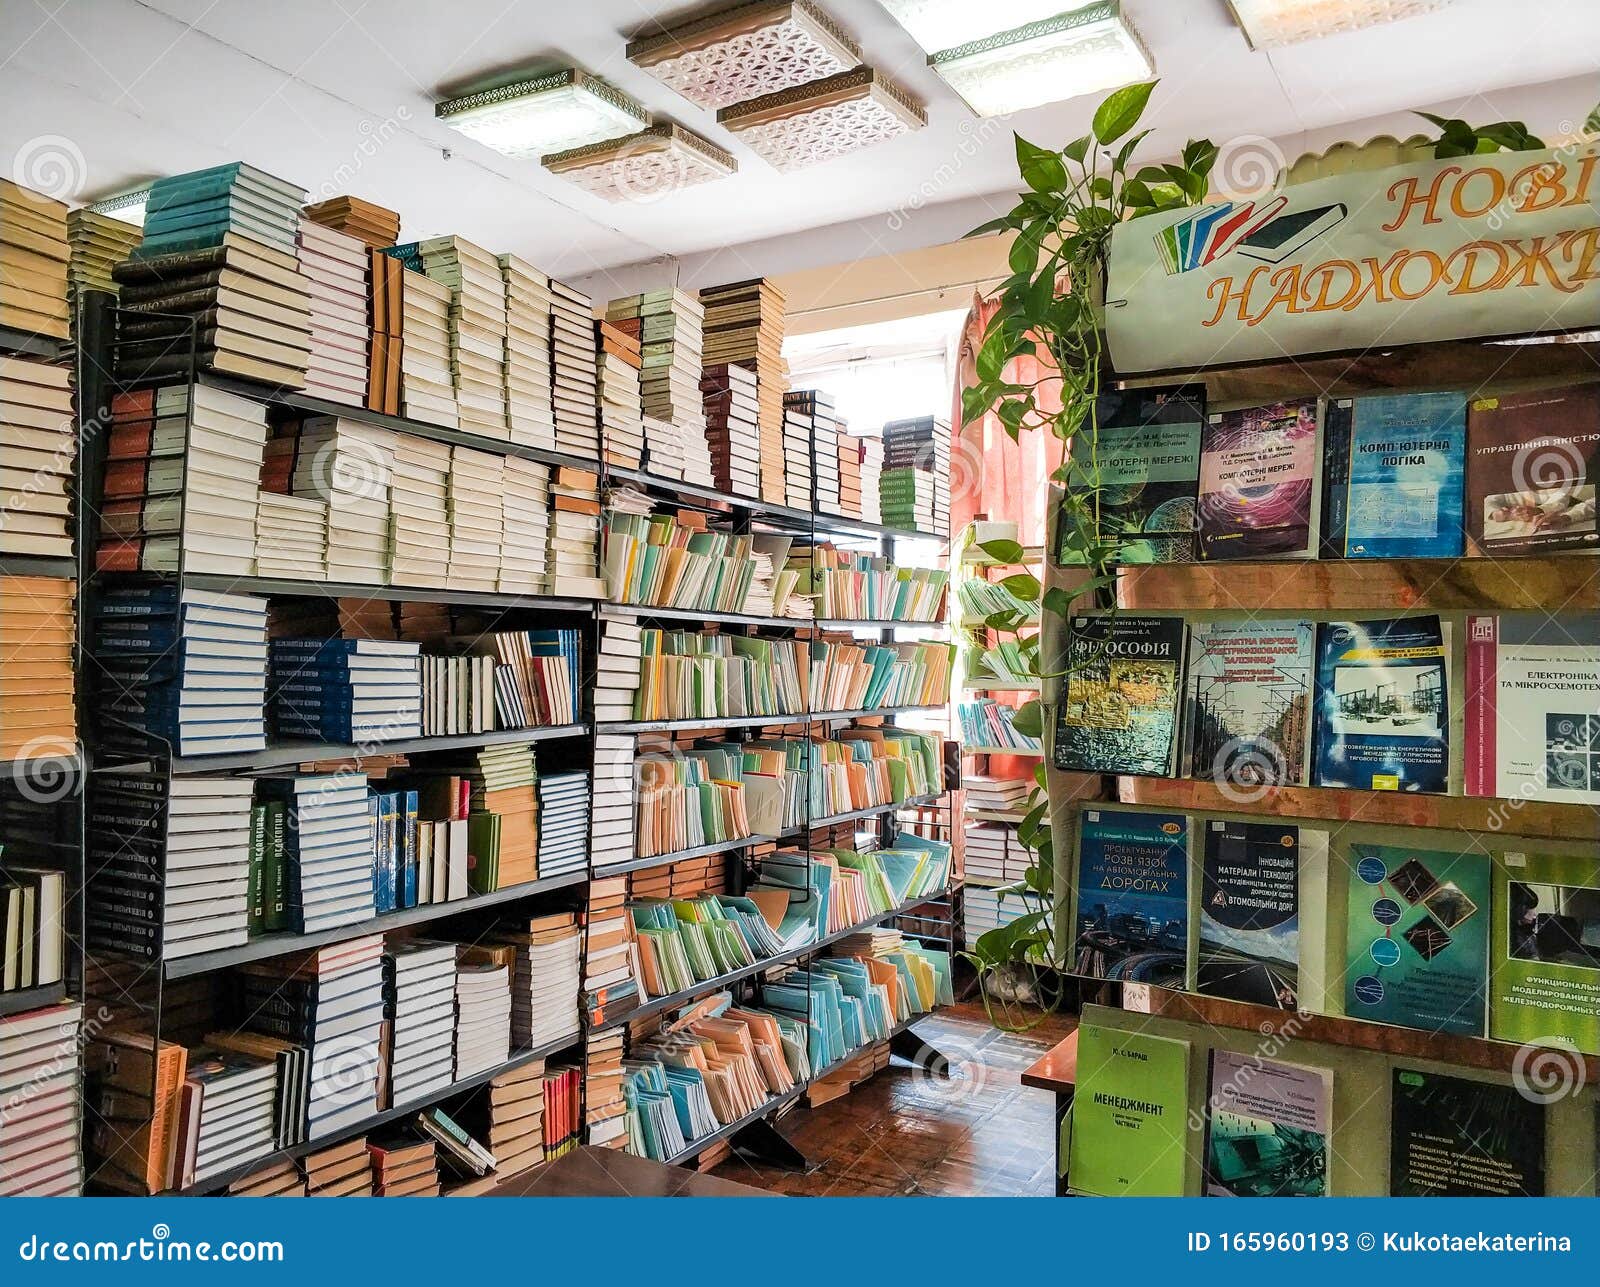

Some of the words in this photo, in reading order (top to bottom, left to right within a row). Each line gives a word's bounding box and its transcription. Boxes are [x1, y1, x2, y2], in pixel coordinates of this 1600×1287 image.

[1381, 149, 1600, 232] НОВІ
[1475, 439, 1550, 455] УПРАВЛІННЯ
[1553, 433, 1600, 447] ЯКІСТЮ
[1151, 455, 1194, 465] МЕРЕЖІ
[1381, 455, 1426, 466] ЛОГІКА
[1268, 463, 1295, 473] МЕРЕЖІ
[1527, 671, 1598, 680] ЕЛЕКТРОНІКА
[1258, 856, 1294, 868] ІННОВАЦІЙНІ
[1106, 867, 1178, 879] АВТОМОБІЛЬНИХ
[1217, 866, 1257, 877] МАТЕРІАЛИ
[1262, 870, 1294, 881] ТЕХНОЛОГІЇ
[1100, 876, 1169, 892] ДОРОГАХ
[1229, 878, 1267, 888] БУДІВНИЦТВА
[1278, 902, 1294, 912] ДОРІГ
[1511, 985, 1589, 1003] МОДЕЛИРОВАНИЕ
[1502, 996, 1594, 1015] ЖЕЛЕЗНОДОРОЖНЫХ
[1127, 1050, 1148, 1061] БАРАШ
[1093, 1092, 1164, 1116] МЕНЕДЖМЕНТ
[1115, 1119, 1136, 1129] ЧАСТИНА
